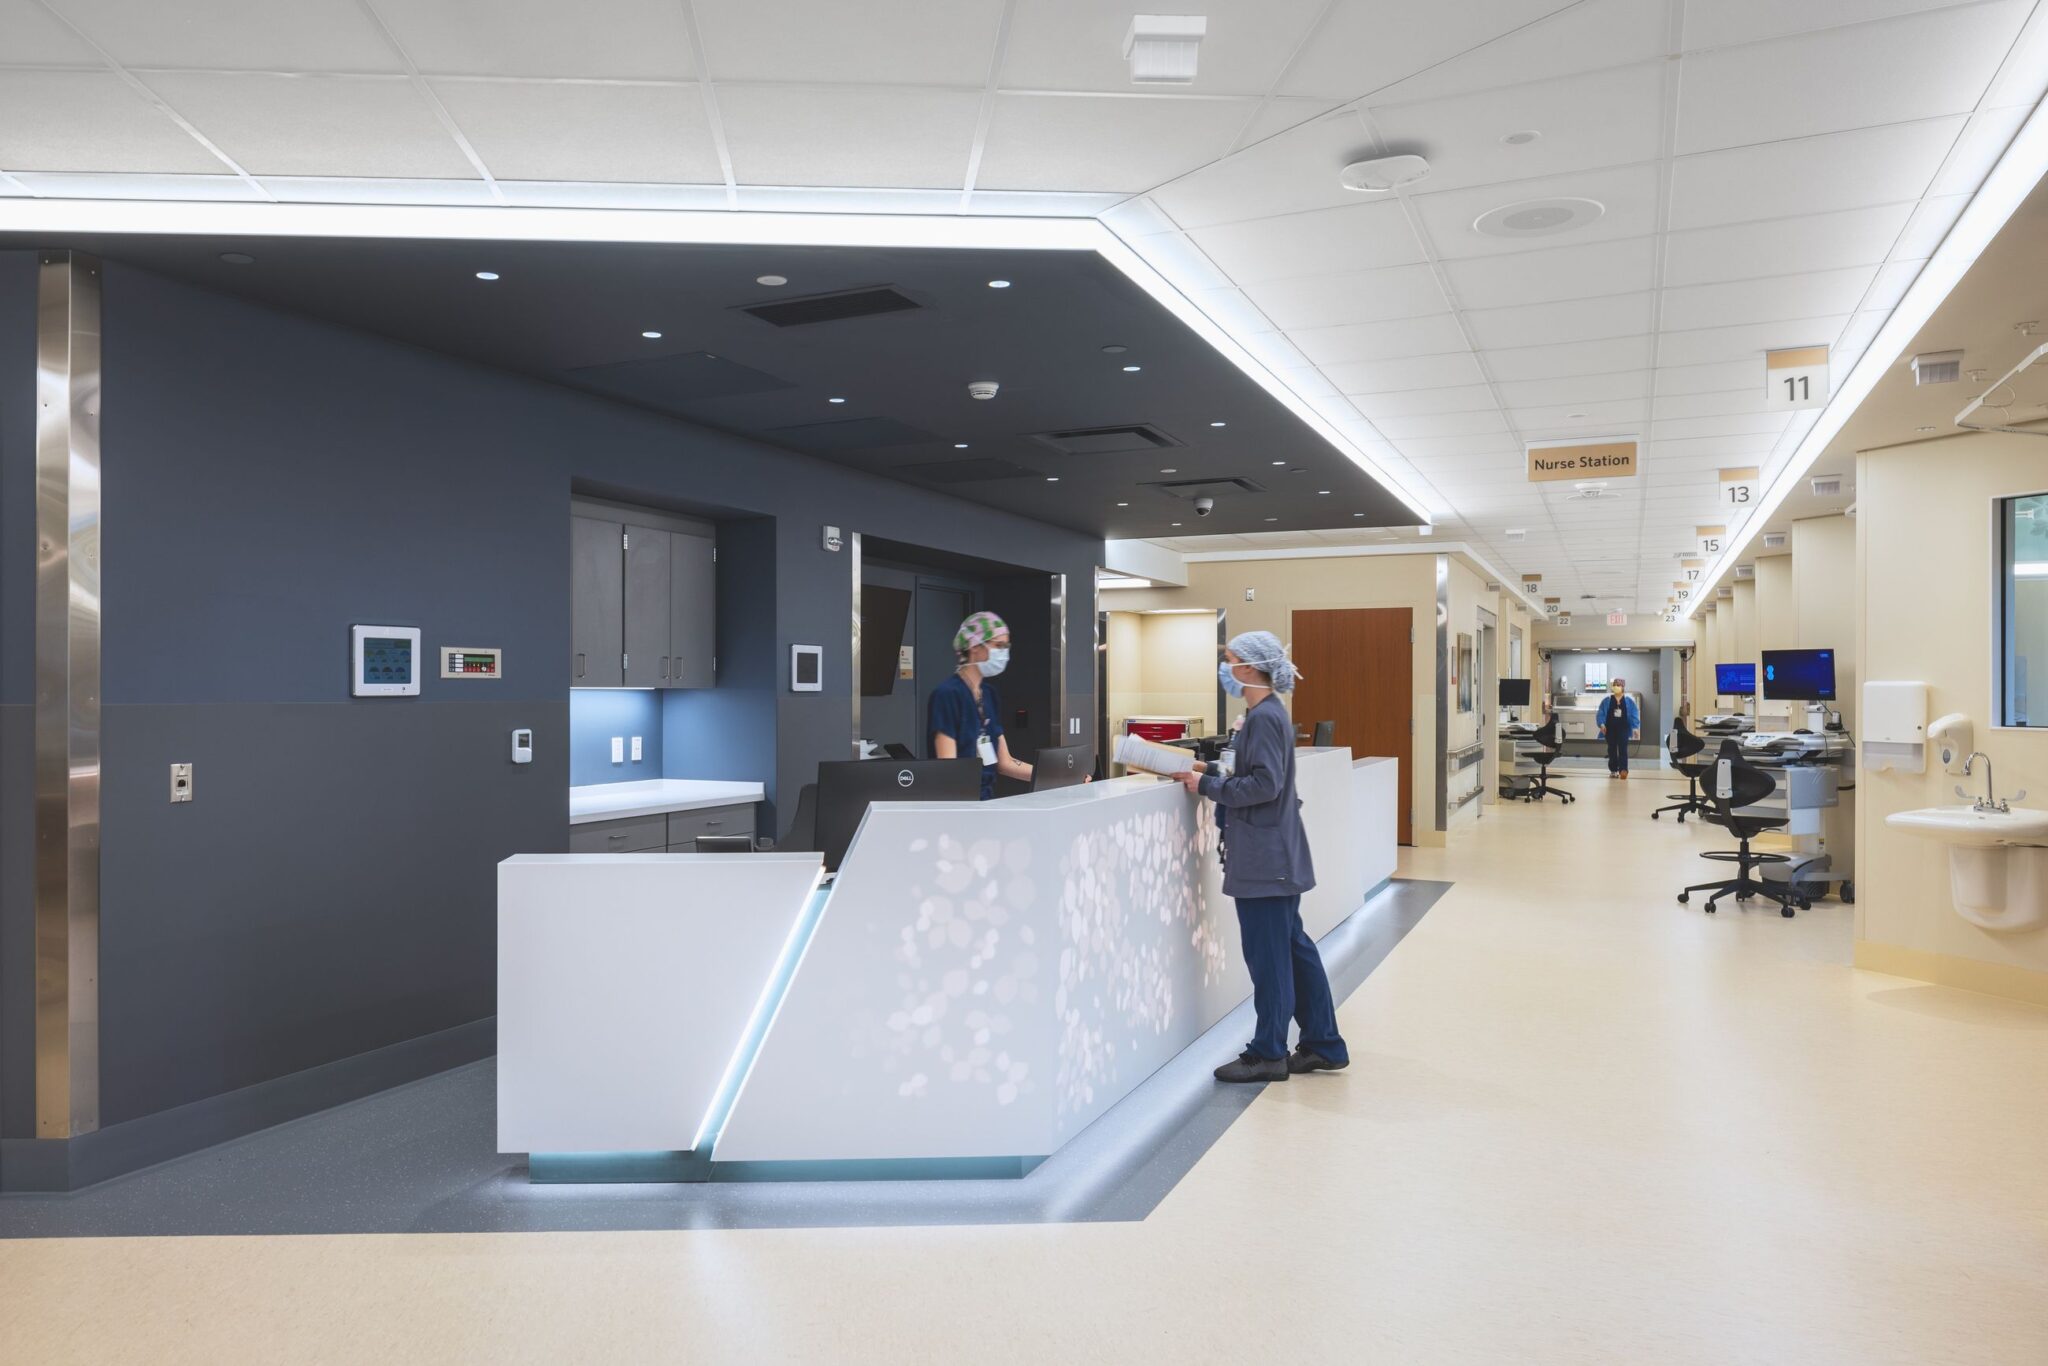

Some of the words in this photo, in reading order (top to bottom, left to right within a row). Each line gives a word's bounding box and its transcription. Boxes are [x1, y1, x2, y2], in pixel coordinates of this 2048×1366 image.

[1784, 376, 1809, 401] 11
[1534, 459, 1575, 470] Nurse
[1579, 455, 1630, 468] Station
[1728, 486, 1750, 503] 13
[1703, 540, 1719, 552] 15
[1687, 570, 1700, 580] 17
[1526, 583, 1538, 593] 18
[1677, 590, 1689, 599] 19
[1546, 605, 1559, 613] 20
[1671, 604, 1681, 613] 21
[1559, 617, 1569, 625] 22
